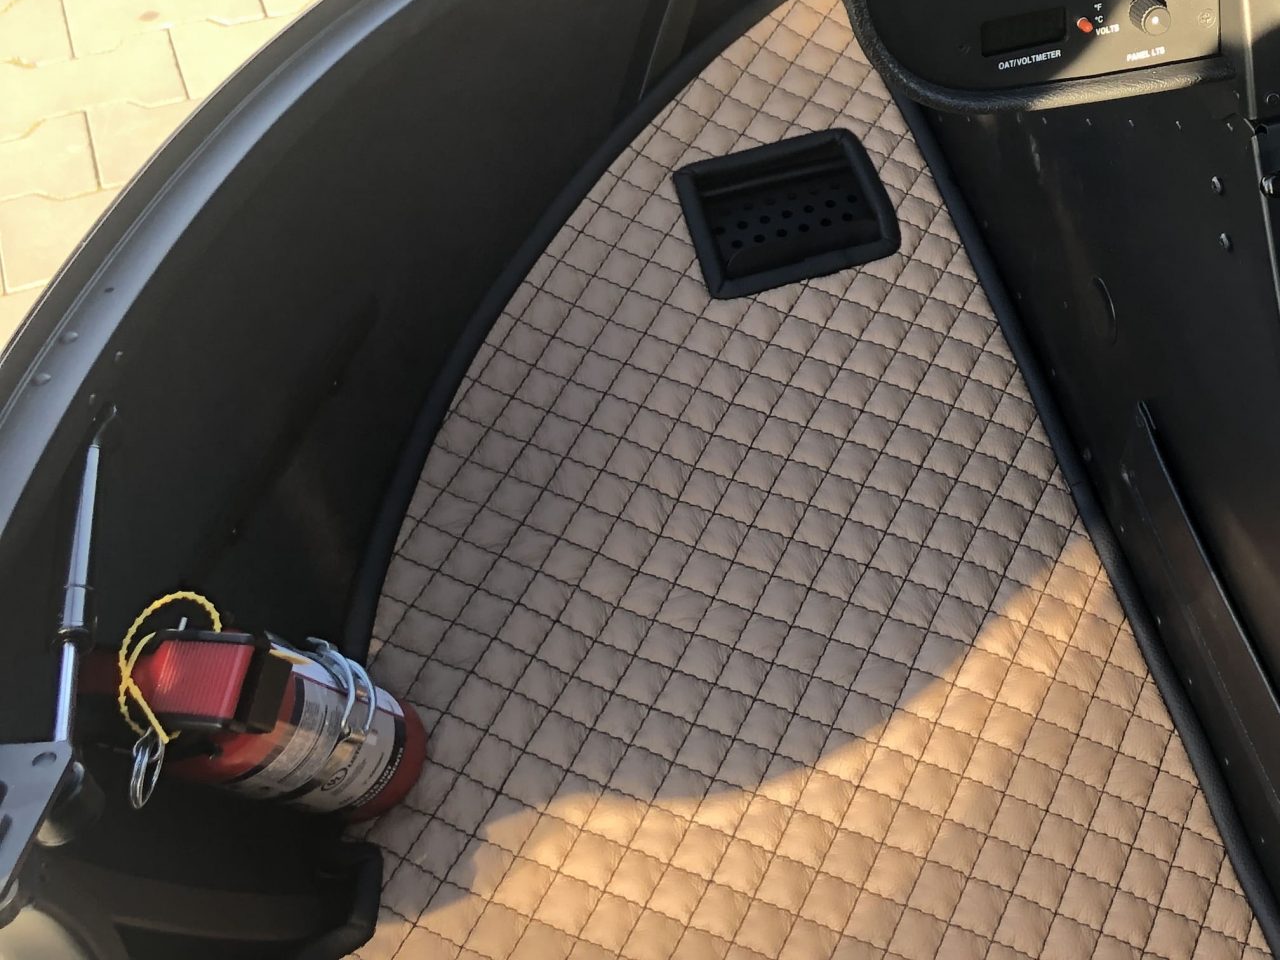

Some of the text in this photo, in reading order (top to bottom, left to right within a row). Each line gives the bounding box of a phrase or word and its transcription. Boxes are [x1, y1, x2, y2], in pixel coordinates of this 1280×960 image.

[1095, 24, 1120, 36] VOLTS
[998, 49, 1062, 70] OAT/VOLTMETER
[1127, 51, 1150, 62] PANEL
